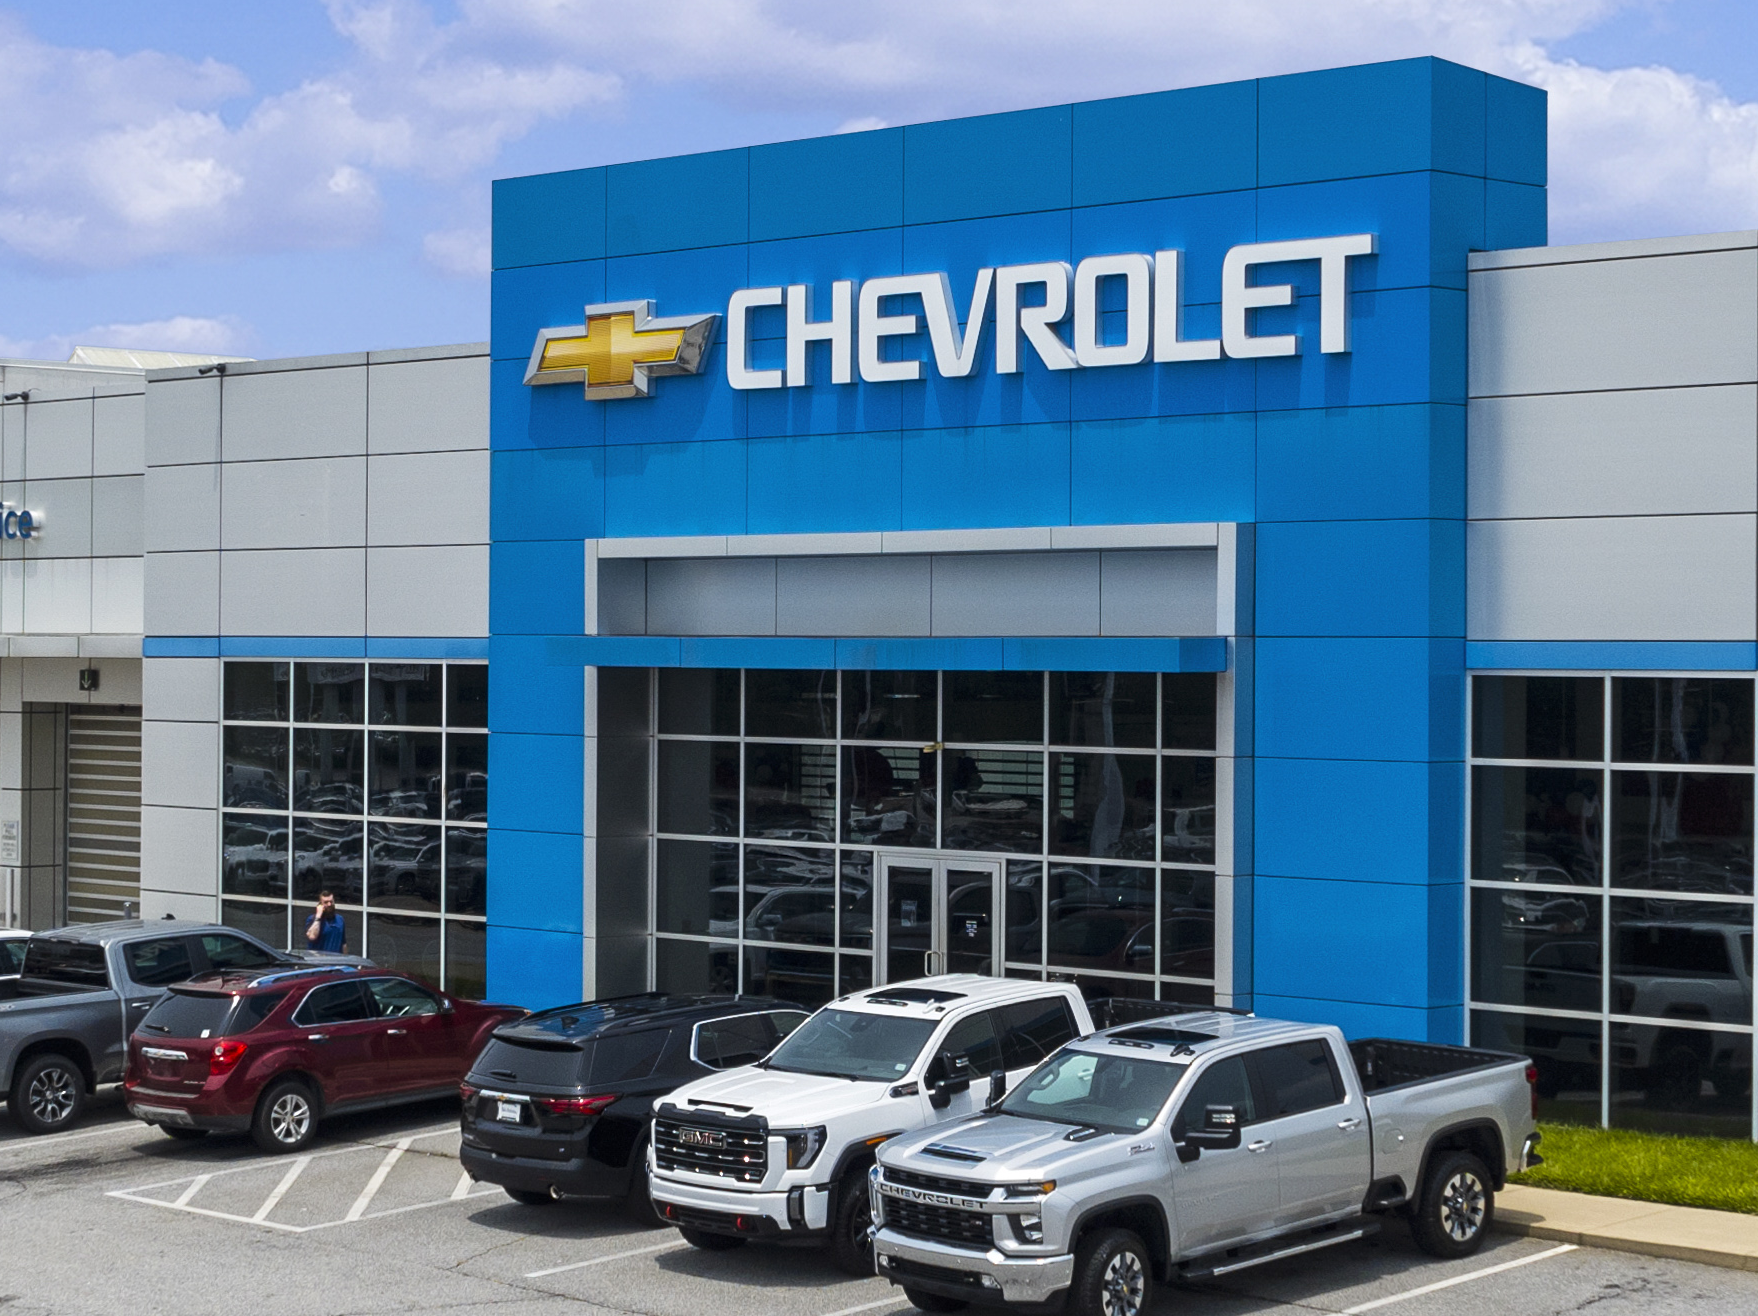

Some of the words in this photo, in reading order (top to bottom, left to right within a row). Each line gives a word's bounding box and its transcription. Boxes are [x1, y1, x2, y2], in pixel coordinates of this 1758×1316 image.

[727, 234, 1378, 390] CHEVROLET
[681, 1129, 724, 1147] GMC
[880, 1183, 988, 1209] CHEVROLET
